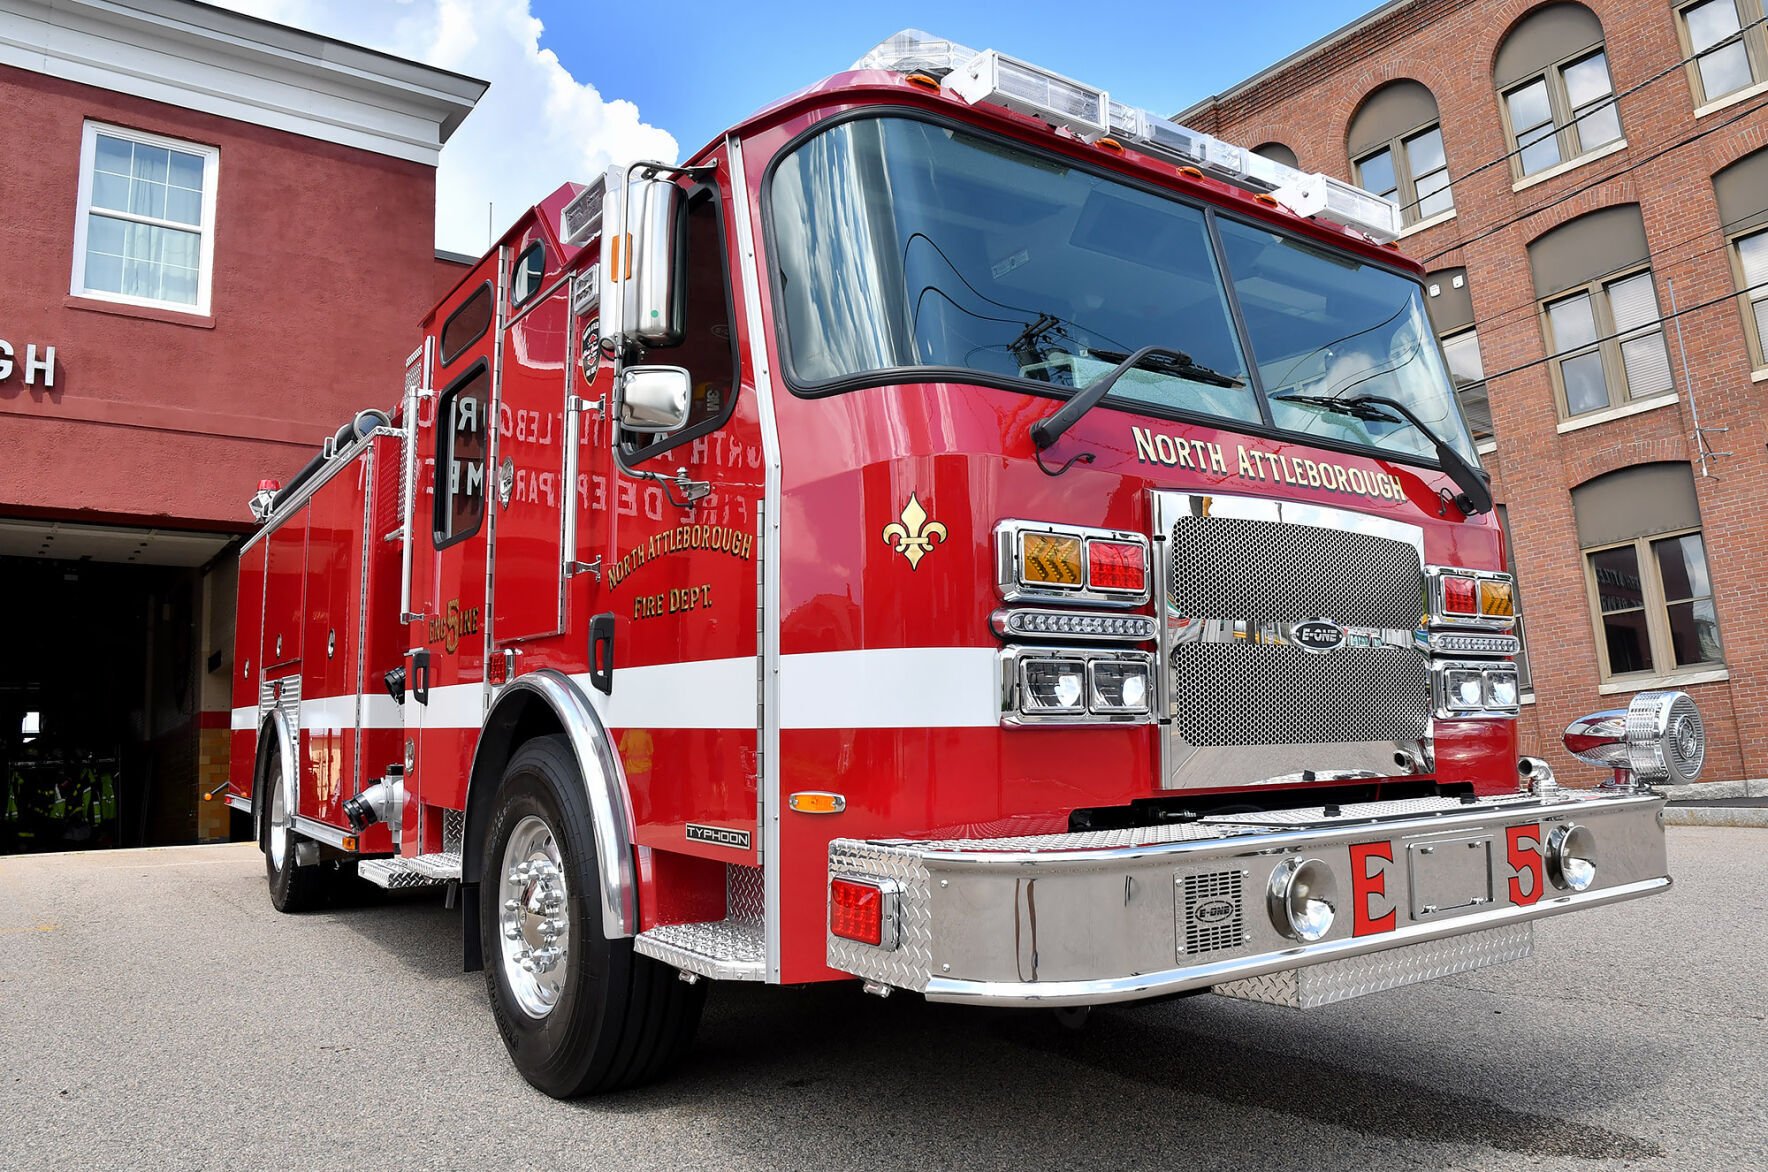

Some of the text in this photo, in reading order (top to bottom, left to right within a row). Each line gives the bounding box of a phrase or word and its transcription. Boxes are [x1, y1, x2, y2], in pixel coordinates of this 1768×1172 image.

[1131, 426, 1406, 502] NORTH ATTLEBOROUGH
[607, 525, 753, 592] NORTH ATTLEBOROUGH
[634, 584, 713, 620] FIRE DEPT.
[1302, 628, 1338, 642] E-ONE
[687, 826, 748, 845] TYPHOON
[1348, 823, 1545, 938] E 5
